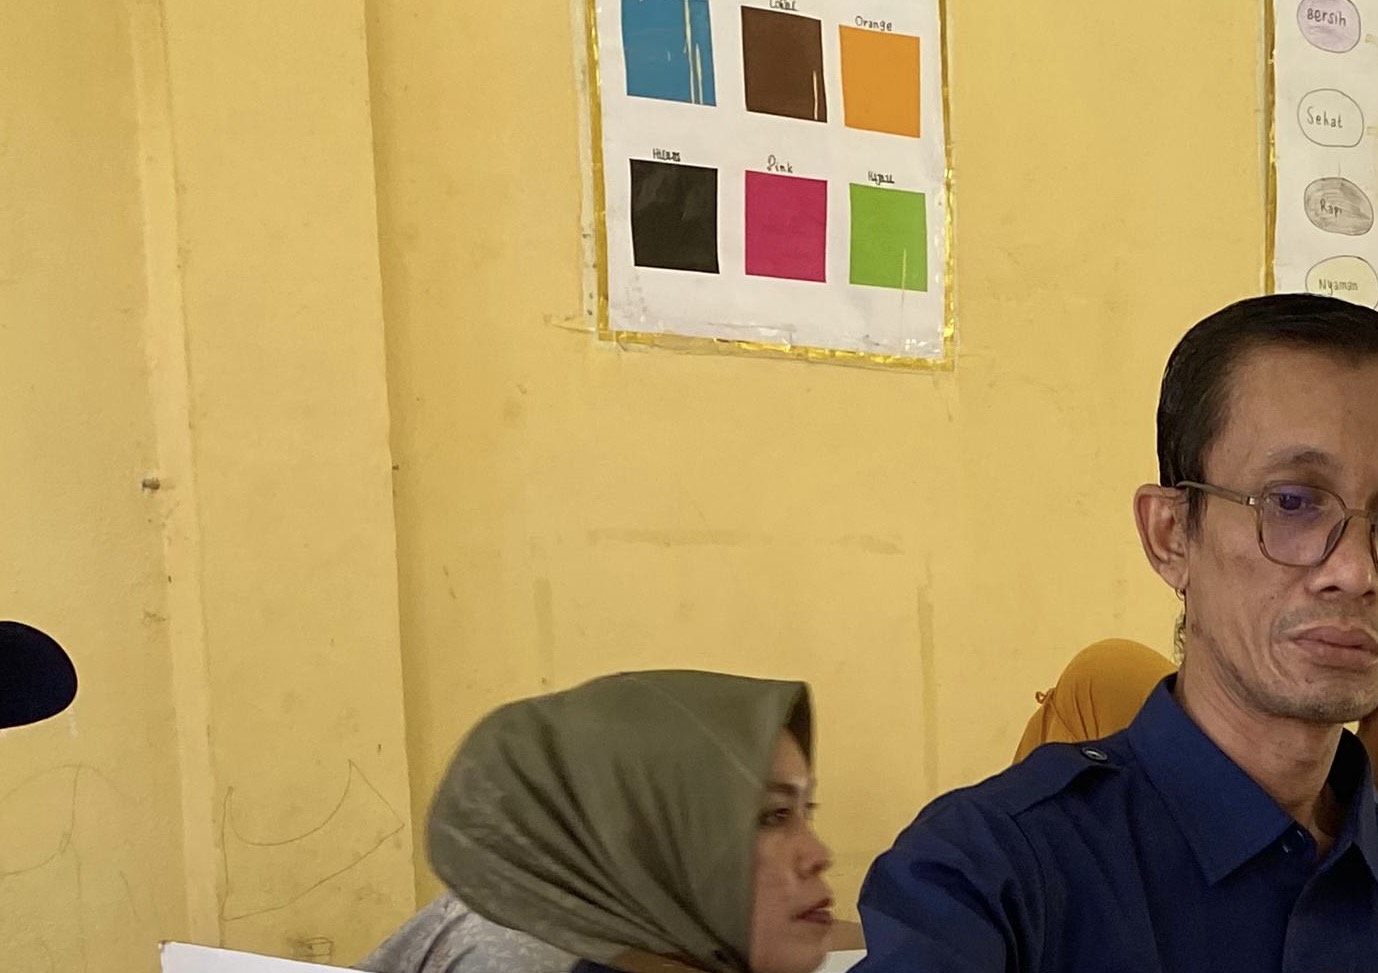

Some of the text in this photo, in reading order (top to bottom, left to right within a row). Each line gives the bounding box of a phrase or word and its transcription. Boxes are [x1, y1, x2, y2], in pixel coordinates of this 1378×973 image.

[855, 15, 893, 31] Orange
[1306, 106, 1344, 129] Sehat
[767, 154, 793, 174] Pink
[1318, 279, 1359, 296] Nyaman
